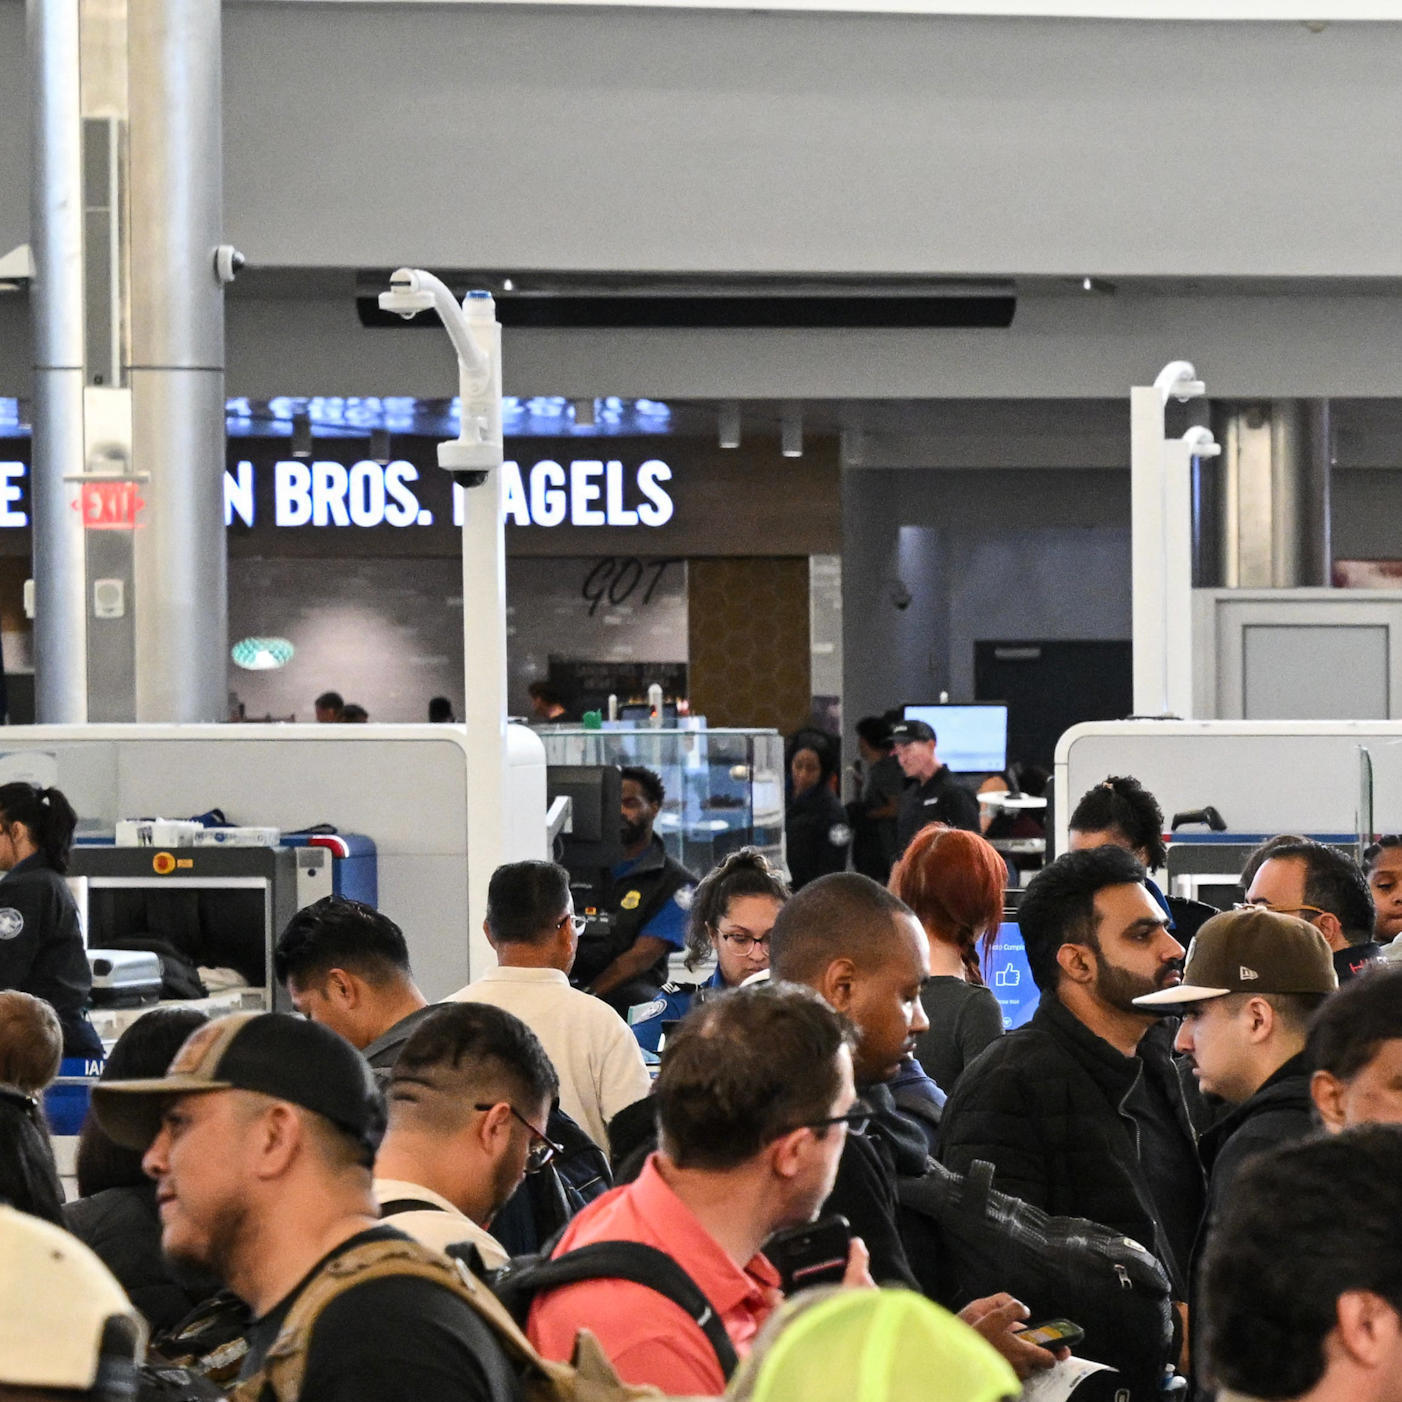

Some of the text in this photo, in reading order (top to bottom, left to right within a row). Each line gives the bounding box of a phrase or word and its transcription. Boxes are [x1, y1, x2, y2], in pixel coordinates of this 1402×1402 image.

[83, 483, 138, 523] EXIT
[275, 460, 433, 527] BROS.
[453, 460, 674, 527] AGELS
